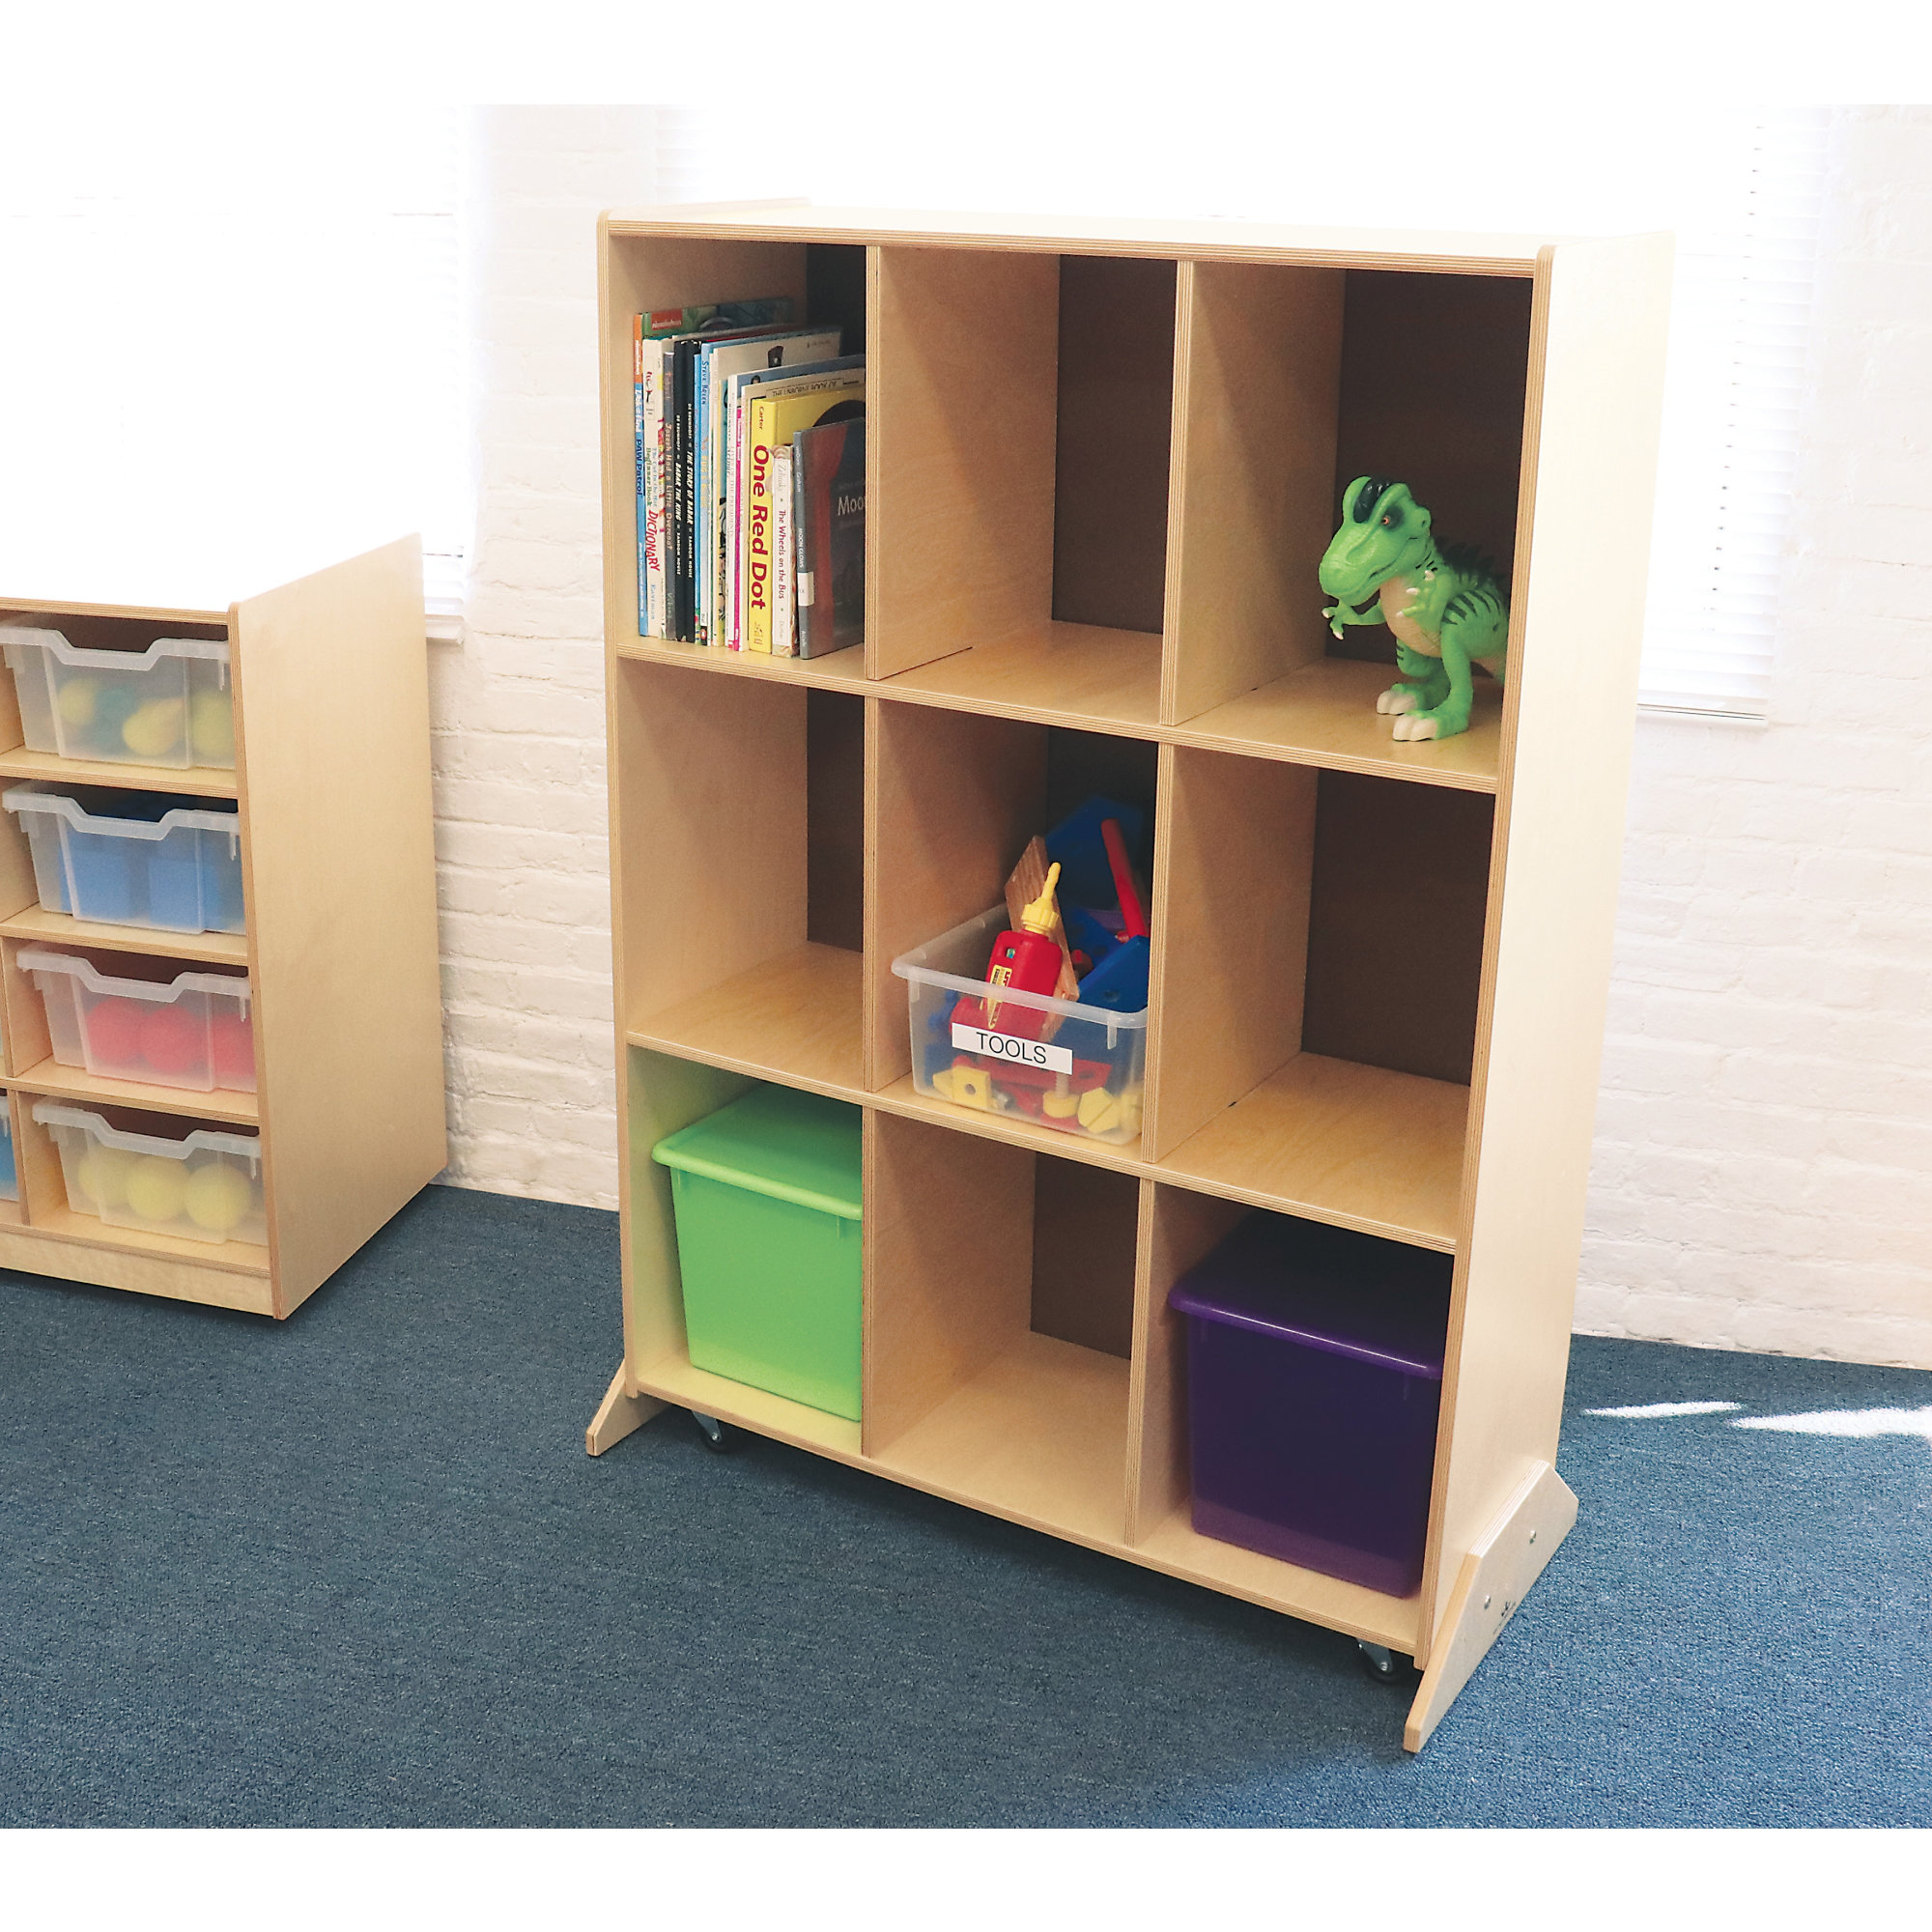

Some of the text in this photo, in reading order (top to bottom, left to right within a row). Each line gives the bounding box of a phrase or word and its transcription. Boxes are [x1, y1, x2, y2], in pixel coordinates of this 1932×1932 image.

[636, 464, 644, 497] Patrol
[753, 444, 770, 497] One
[687, 490, 694, 499] OF
[838, 495, 864, 516] Moo
[645, 509, 661, 572] DICTIONARY
[752, 504, 768, 555] Red
[779, 557, 783, 568] on
[751, 561, 766, 610] Dot
[778, 583, 786, 600] Bus
[976, 1031, 1047, 1065] TOOLS
